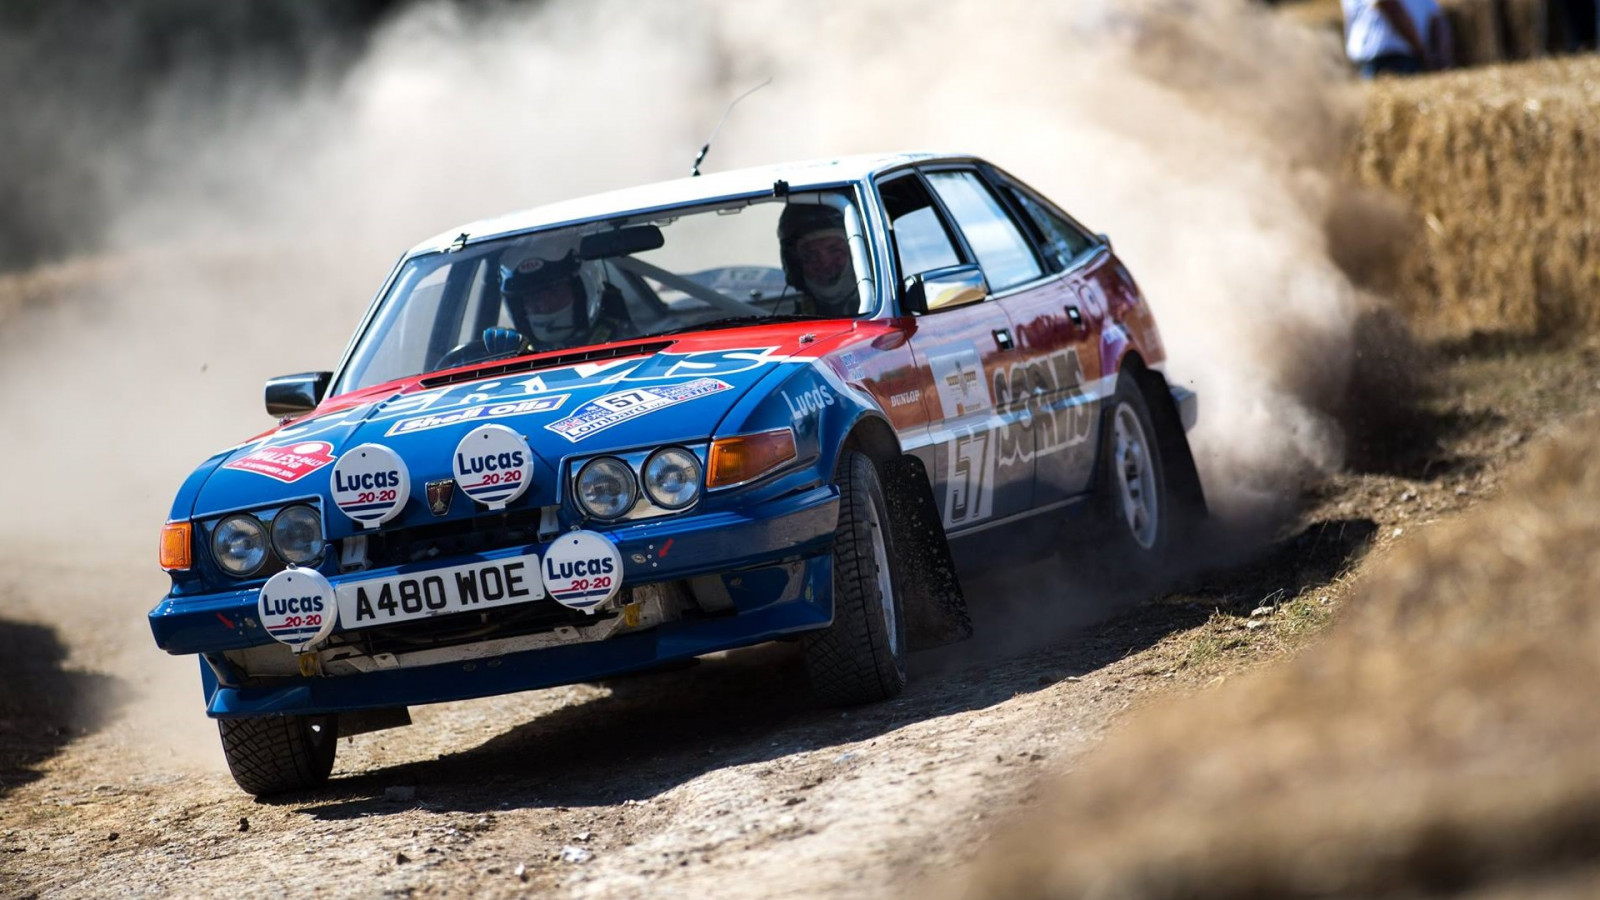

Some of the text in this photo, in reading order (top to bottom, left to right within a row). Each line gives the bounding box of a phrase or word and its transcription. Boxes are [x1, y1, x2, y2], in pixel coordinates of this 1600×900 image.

[605, 392, 645, 408] 57
[781, 383, 835, 420] Lucas
[890, 389, 921, 408] DUNLOP
[399, 405, 483, 431] Shell
[487, 398, 552, 416] Oils
[565, 404, 648, 437] Lombard
[457, 450, 524, 476] Lucas
[335, 469, 399, 492] Lucas
[482, 470, 522, 486] 20-20
[951, 432, 990, 524] 57
[358, 489, 396, 503] 20-20
[546, 556, 614, 581] Lucas
[355, 562, 529, 622] A480 WOE
[571, 576, 611, 592] 20-20
[263, 594, 324, 616] Lucas
[285, 614, 322, 628] 20-20
